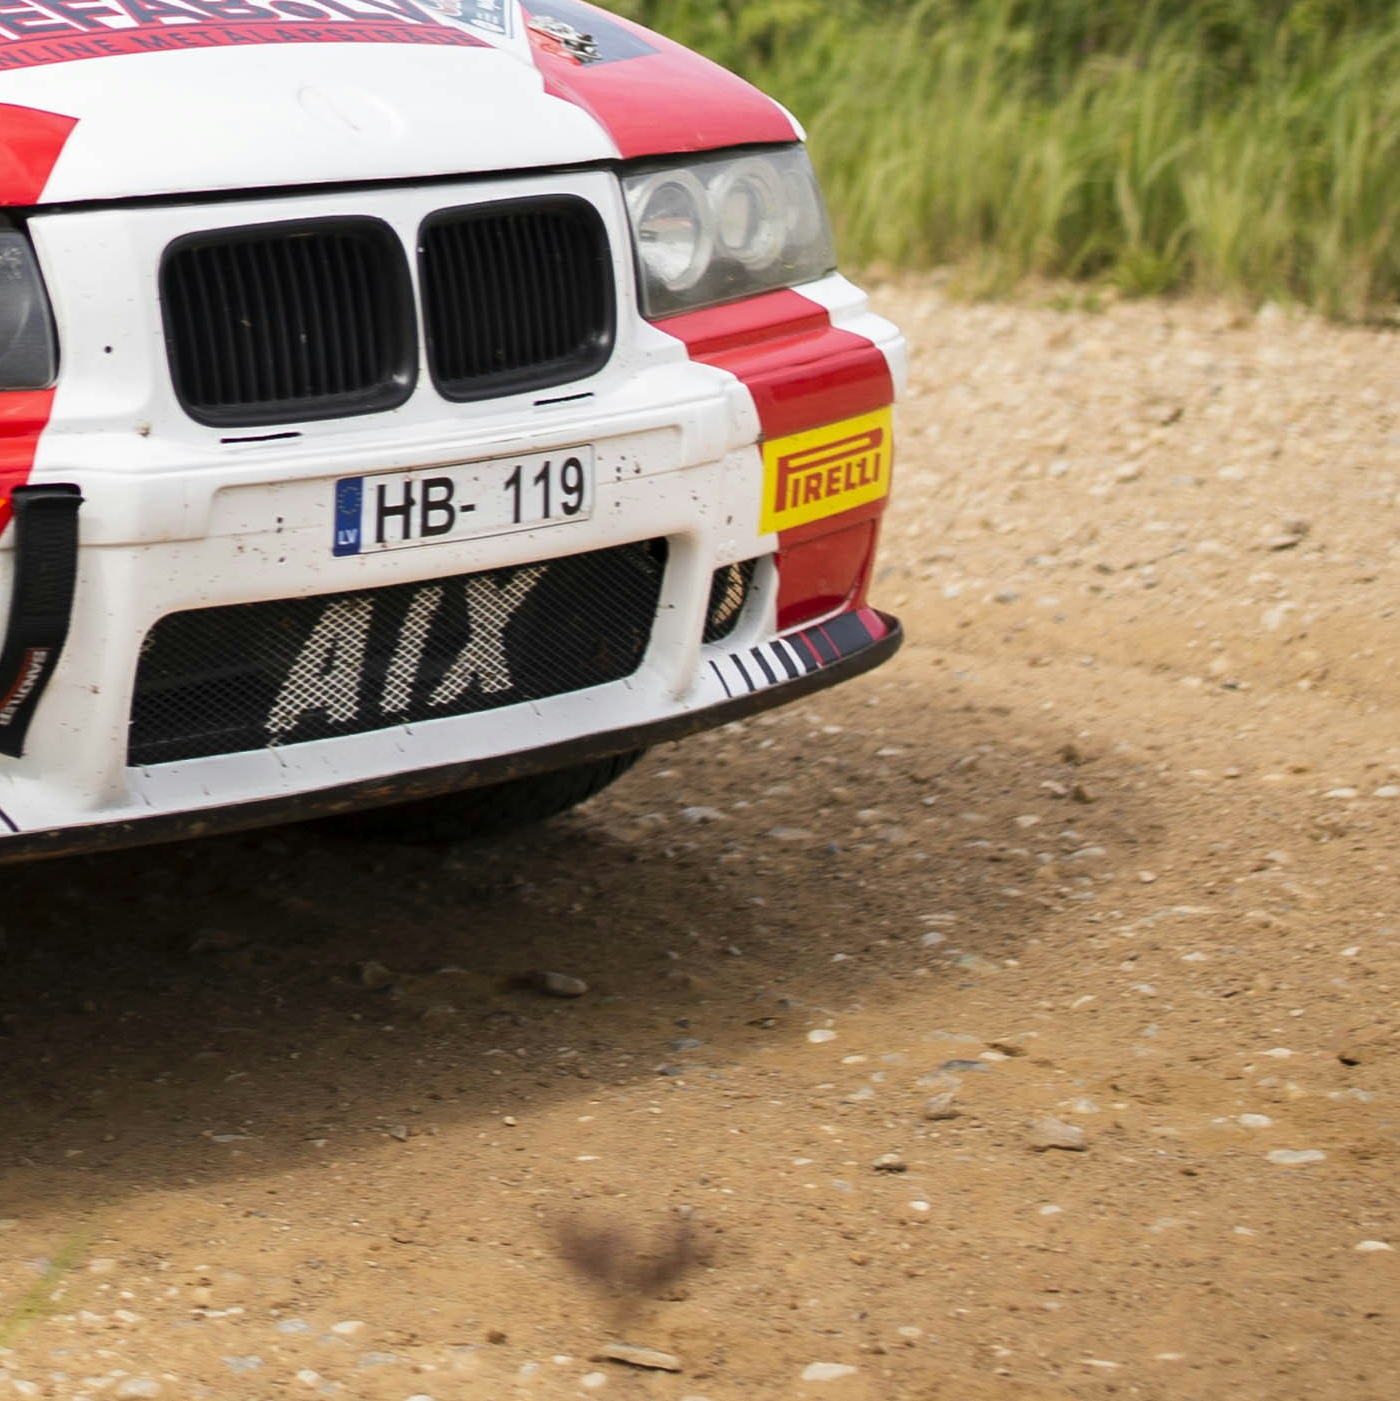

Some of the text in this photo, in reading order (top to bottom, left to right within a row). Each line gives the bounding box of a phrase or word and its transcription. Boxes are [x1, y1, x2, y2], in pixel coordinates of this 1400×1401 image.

[774, 426, 884, 513] PIRELLI
[338, 529, 357, 545] LV
[265, 565, 547, 734] AIX
